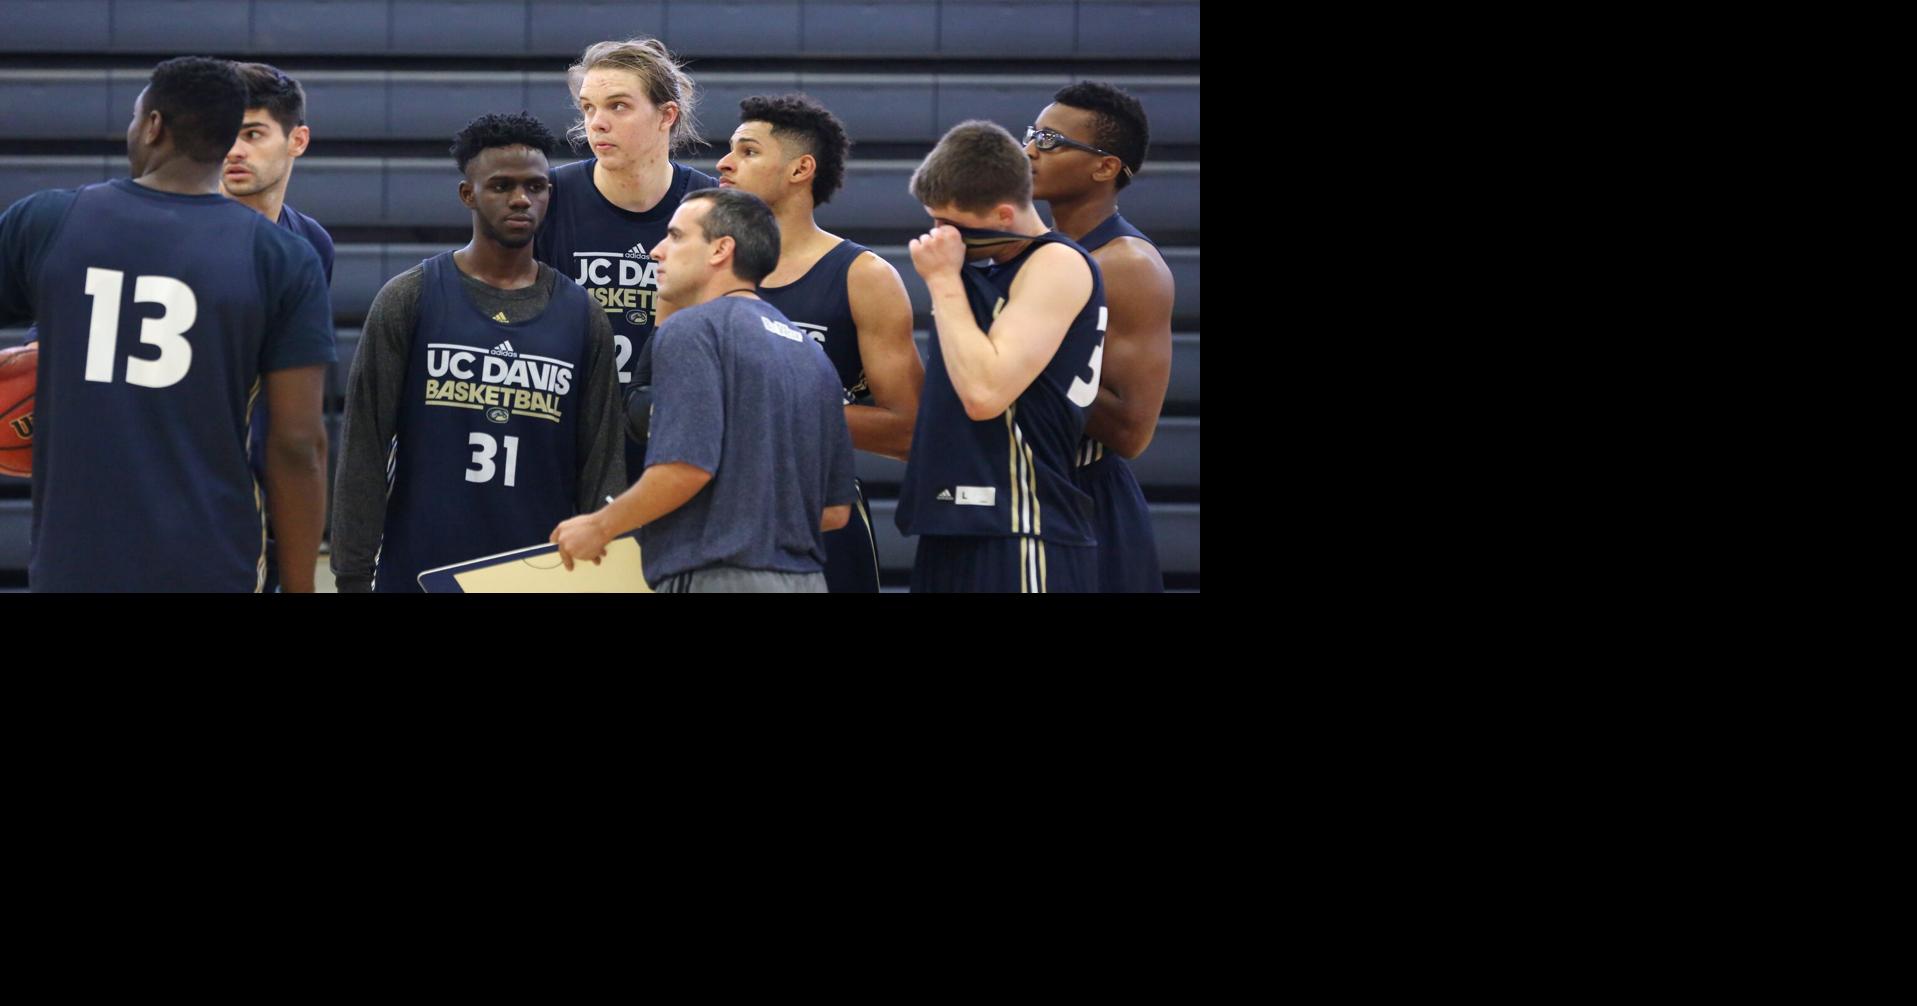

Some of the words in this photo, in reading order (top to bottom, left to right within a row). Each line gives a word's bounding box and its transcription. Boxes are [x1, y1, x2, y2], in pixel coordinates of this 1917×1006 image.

[625, 252, 650, 260] adidas
[85, 267, 197, 388] 13
[427, 349, 476, 379] UC
[482, 355, 573, 395] DAVIS
[490, 349, 518, 358] adidas
[425, 379, 562, 417] BASKETBALL
[465, 432, 519, 487] 31
